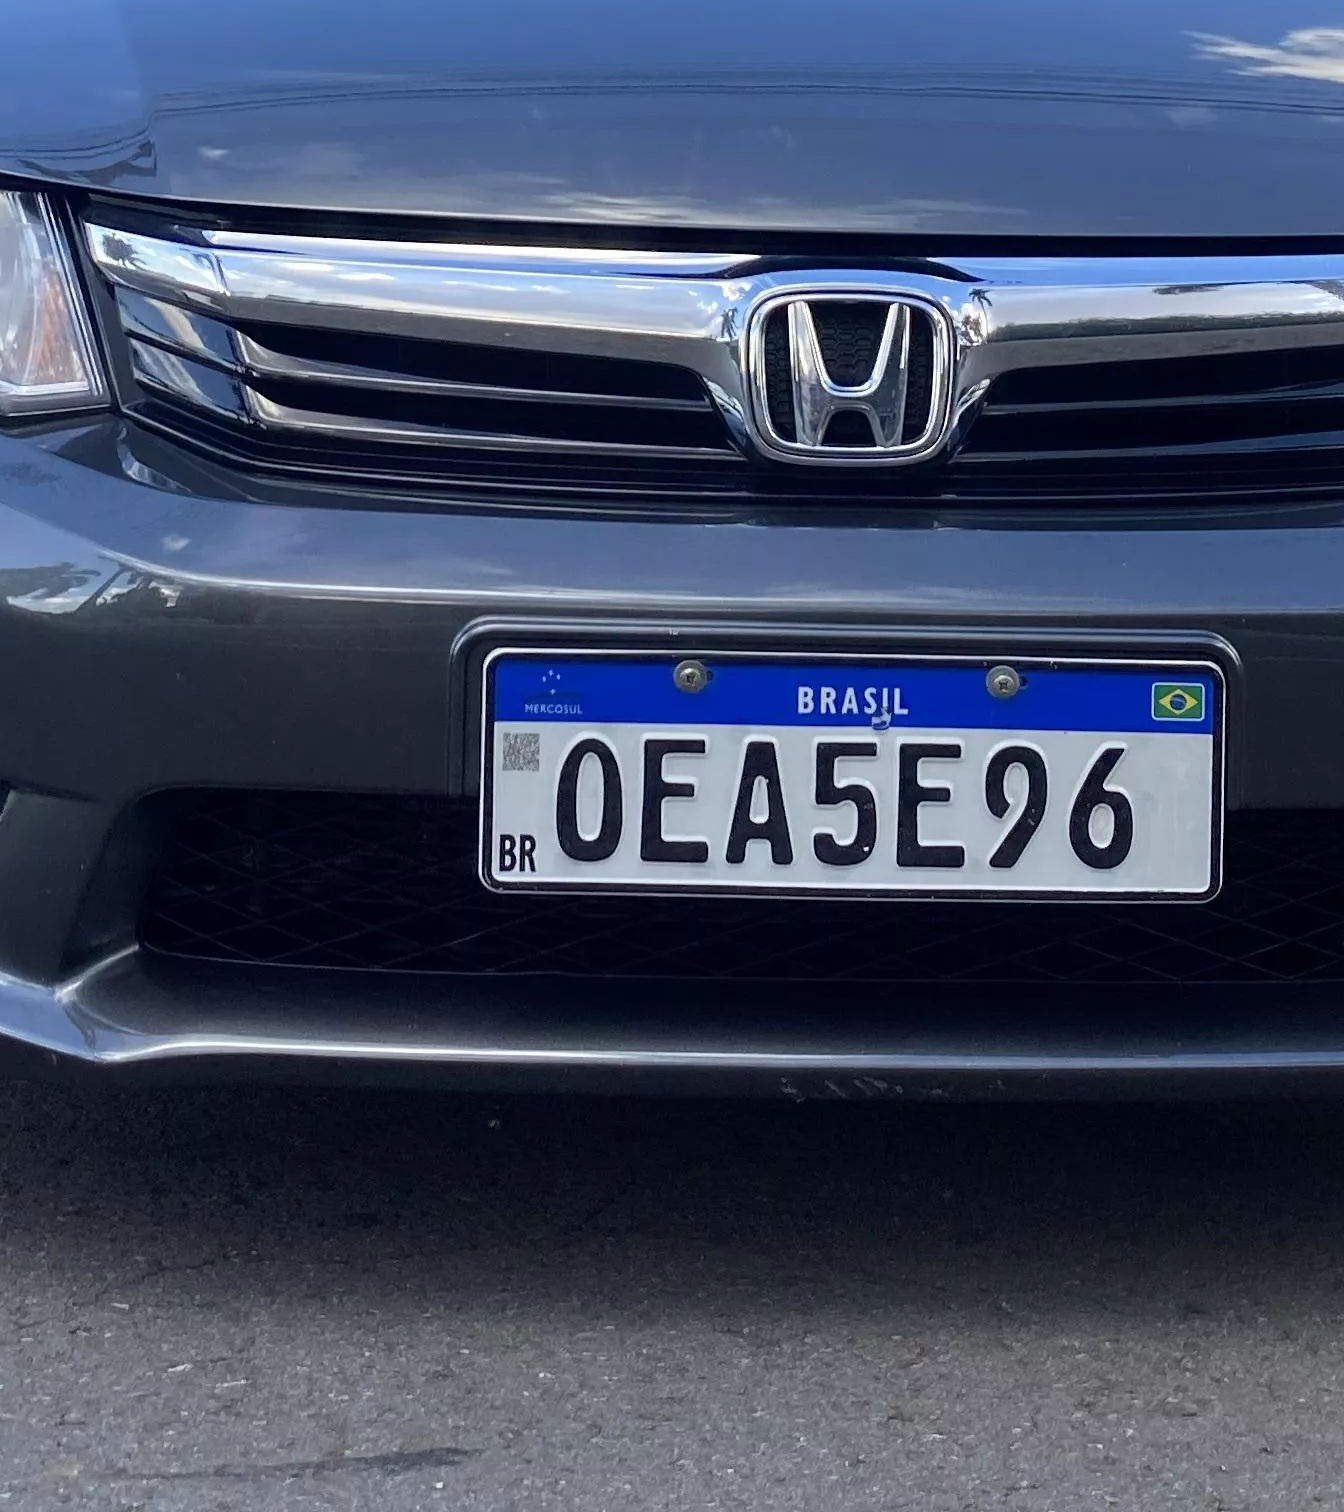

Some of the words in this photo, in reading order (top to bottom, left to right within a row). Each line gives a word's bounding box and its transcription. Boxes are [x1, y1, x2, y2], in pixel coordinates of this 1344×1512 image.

[524, 703, 583, 715] MERCOSUL
[797, 685, 909, 715] BRASIL
[556, 738, 1134, 870] OEA5E96
[498, 833, 537, 874] BR
